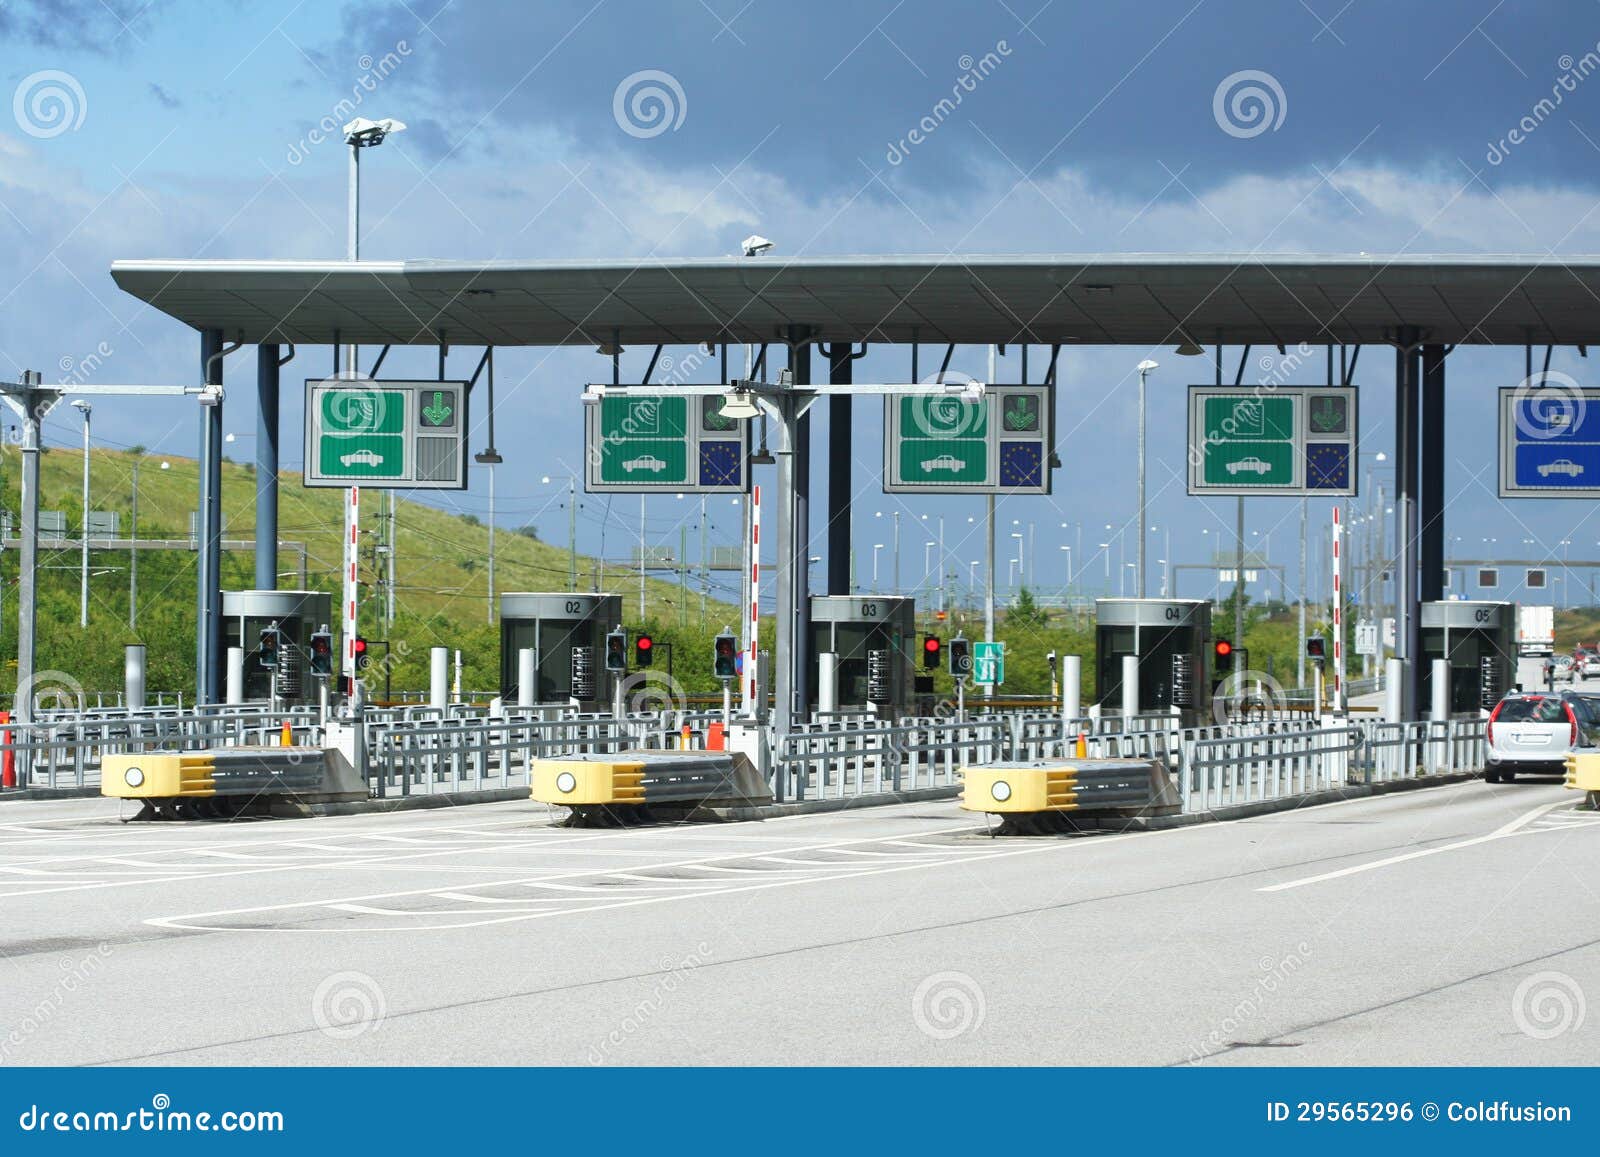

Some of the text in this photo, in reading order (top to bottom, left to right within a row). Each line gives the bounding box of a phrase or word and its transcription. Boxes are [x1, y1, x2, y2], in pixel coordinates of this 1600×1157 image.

[565, 601, 580, 614] 02
[862, 604, 876, 617] 03
[1165, 608, 1180, 621] 04
[1475, 610, 1489, 623] 05
